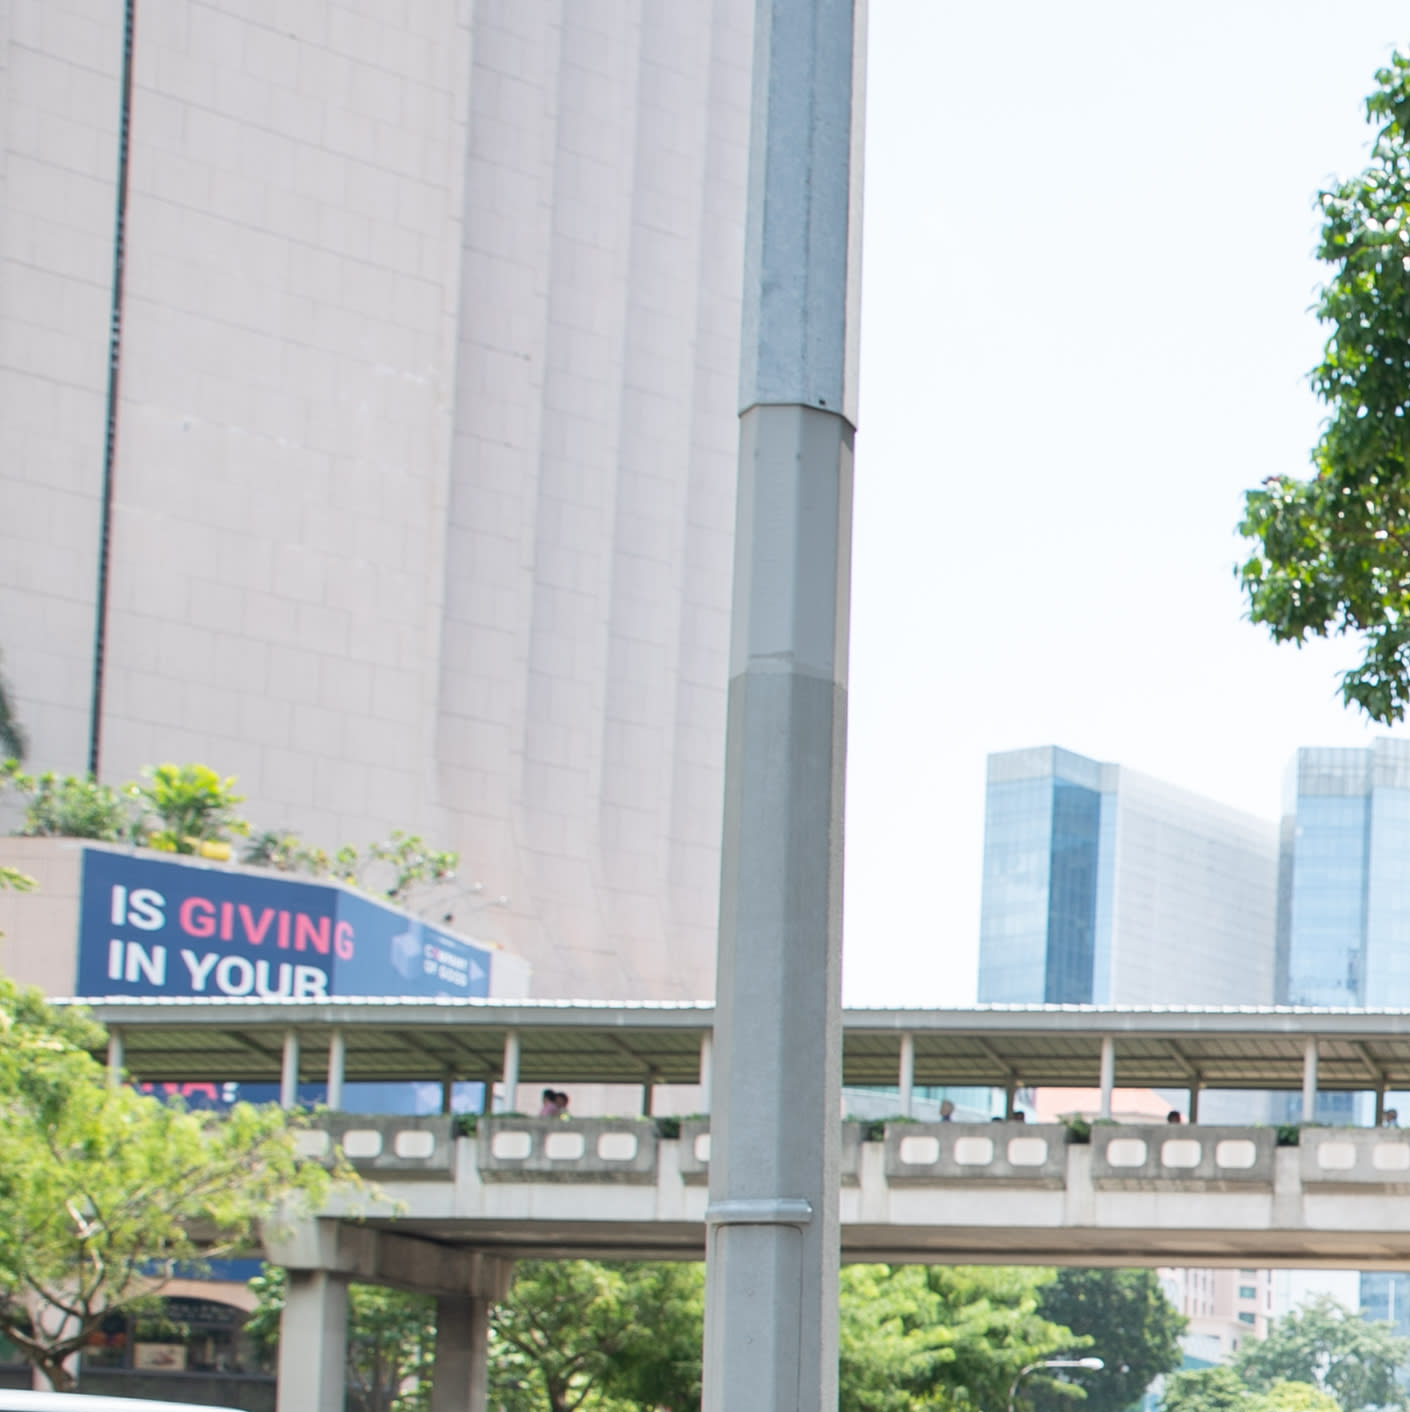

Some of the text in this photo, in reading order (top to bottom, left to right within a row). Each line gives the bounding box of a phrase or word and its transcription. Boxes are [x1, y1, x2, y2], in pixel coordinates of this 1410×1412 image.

[110, 884, 355, 961] IS GIVING
[107, 939, 329, 998] IN YOUR
